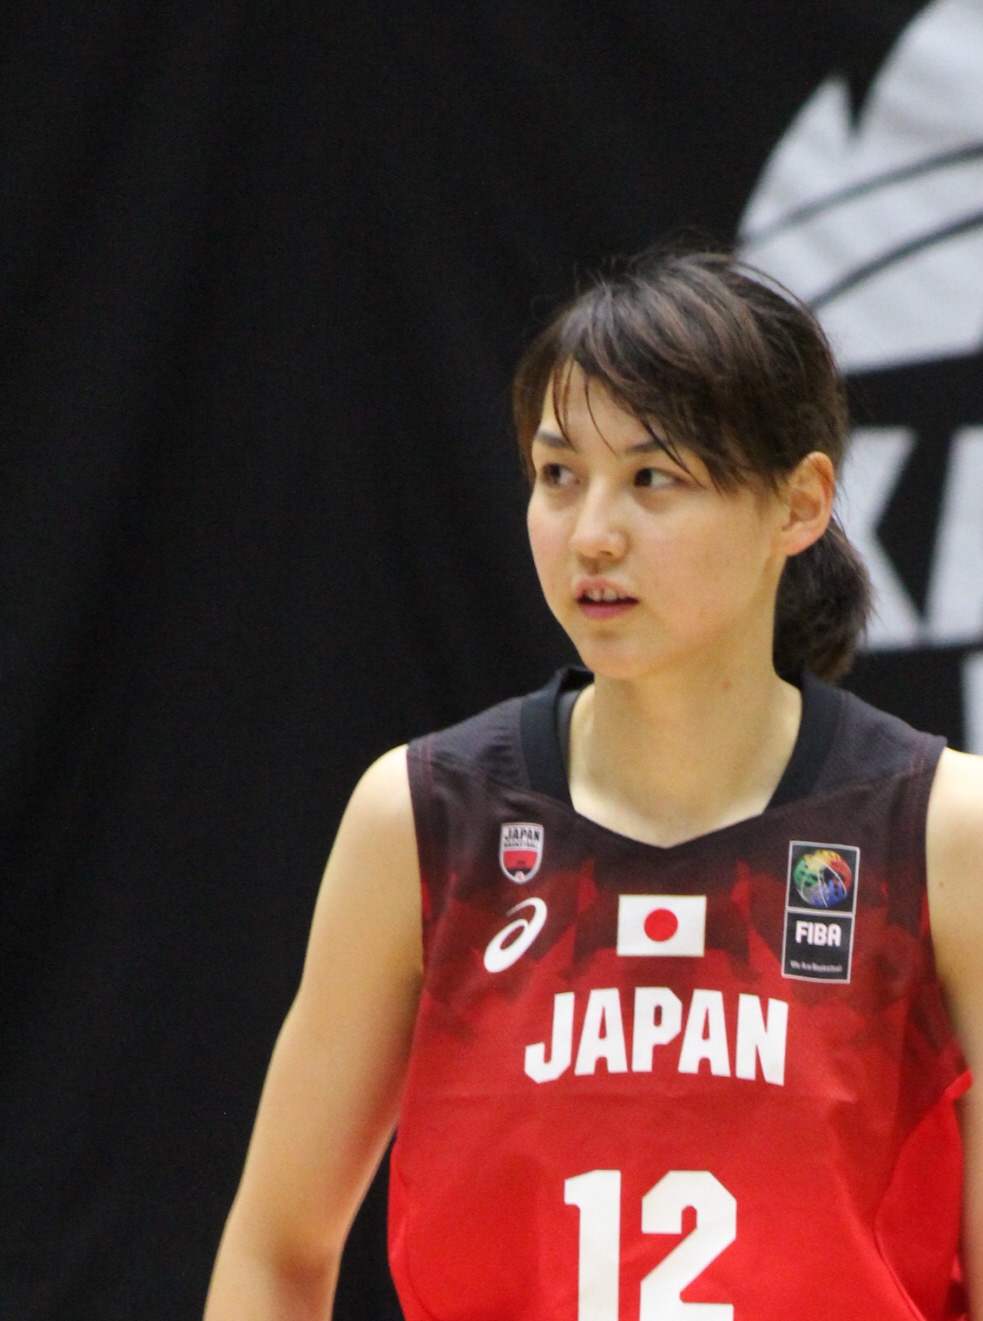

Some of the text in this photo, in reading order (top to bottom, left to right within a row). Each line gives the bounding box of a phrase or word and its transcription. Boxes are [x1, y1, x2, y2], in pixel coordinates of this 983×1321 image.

[504, 827, 541, 841] JAPAN
[795, 920, 842, 947] FIBA
[523, 986, 789, 1086] JAPAN
